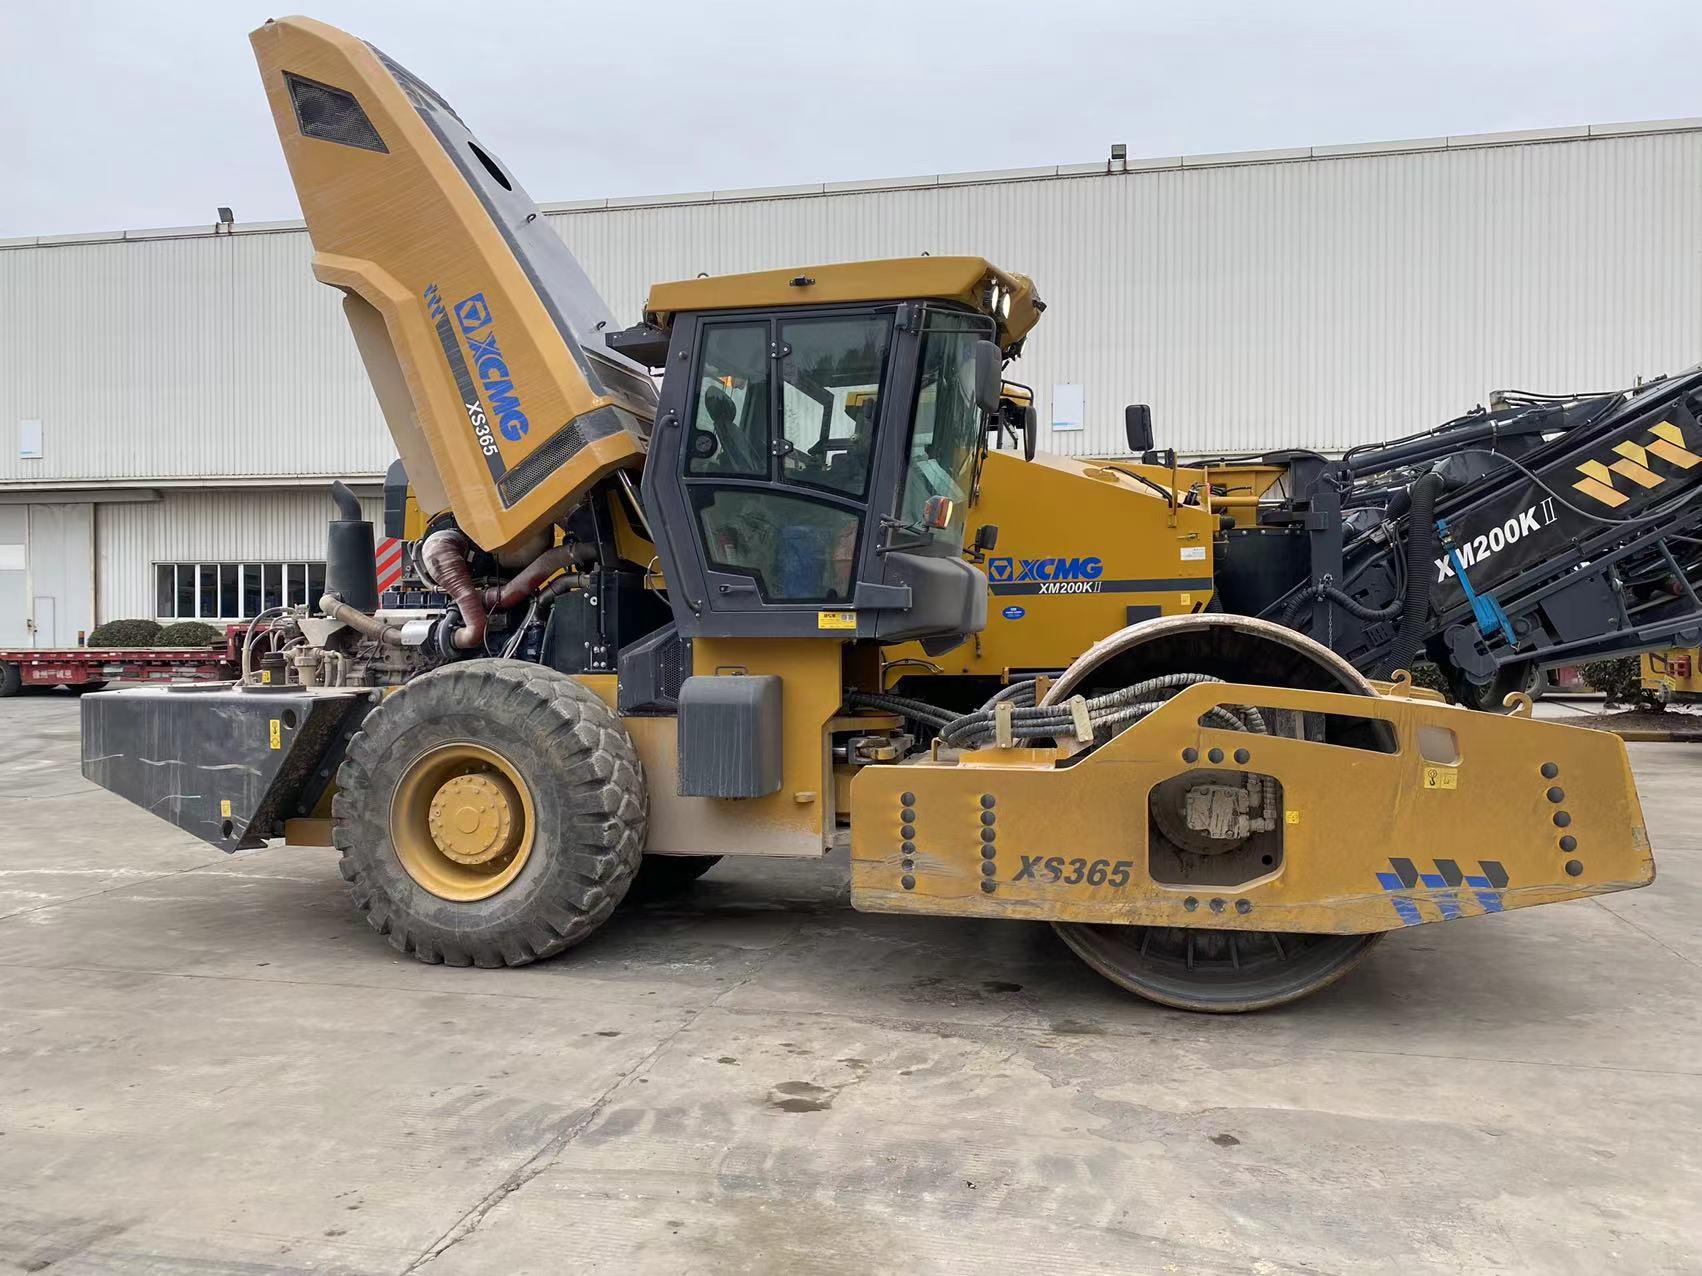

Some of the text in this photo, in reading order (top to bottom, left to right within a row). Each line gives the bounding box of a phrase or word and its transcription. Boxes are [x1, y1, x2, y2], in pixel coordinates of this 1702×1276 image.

[466, 331, 529, 441] XCMG
[465, 400, 498, 456] XS365
[1016, 557, 1104, 581] XCMG
[1012, 855, 1134, 888] XS365
